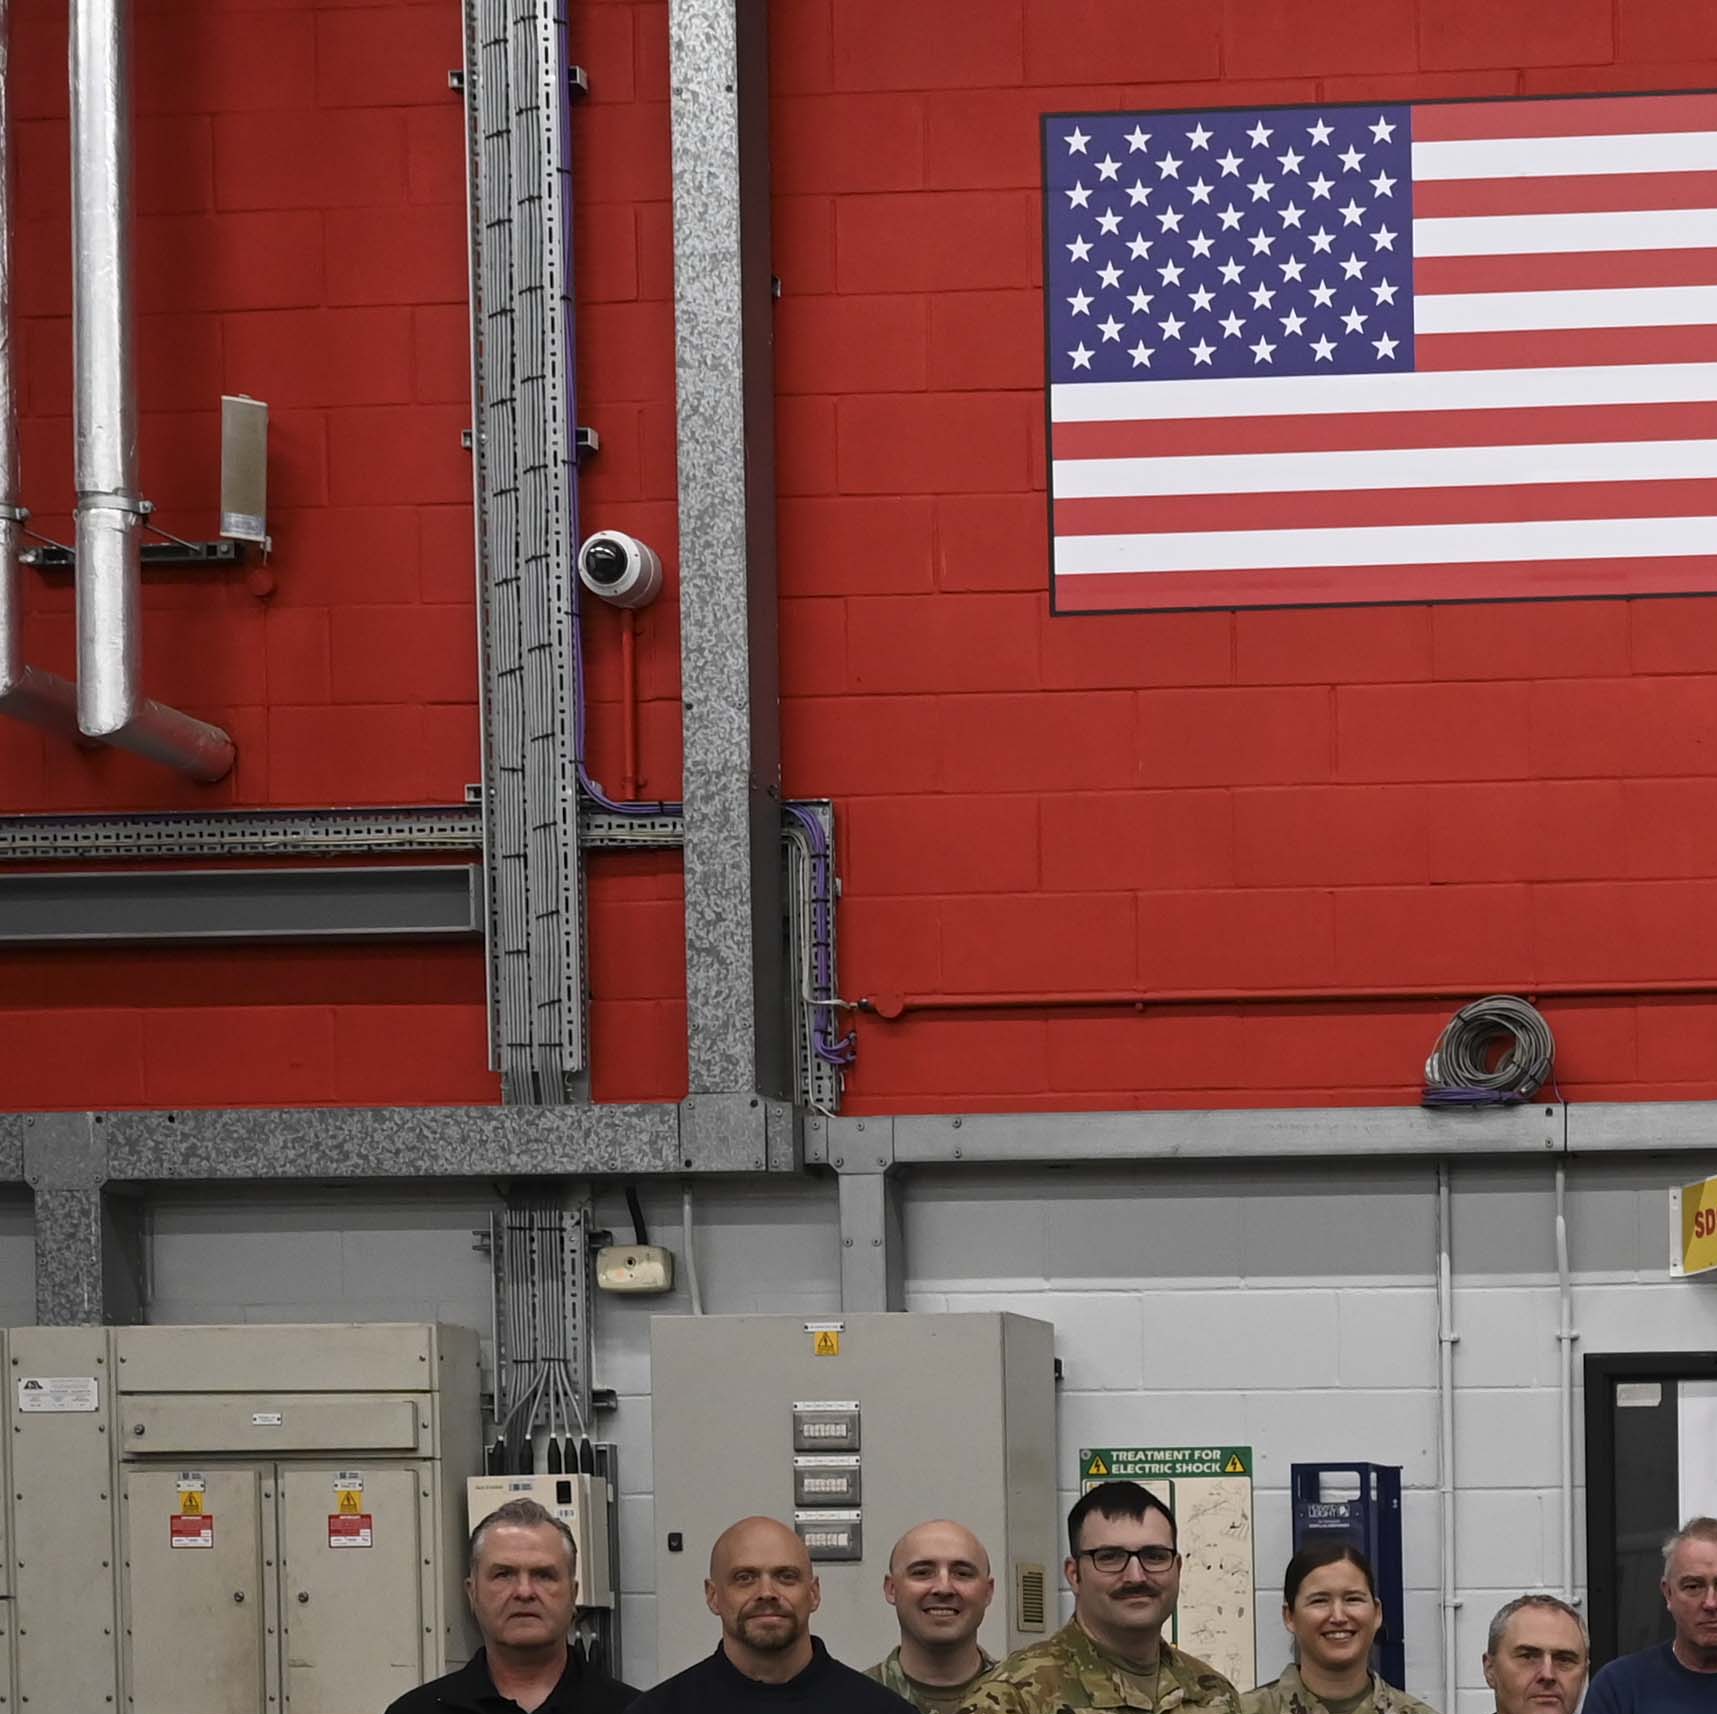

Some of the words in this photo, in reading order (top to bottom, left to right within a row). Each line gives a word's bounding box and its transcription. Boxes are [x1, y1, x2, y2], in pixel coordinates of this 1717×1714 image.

[1111, 1450, 1191, 1462] TREATMENT
[1194, 1450, 1221, 1460] FOR
[1111, 1463, 1172, 1474] ELECTRIC
[1175, 1462, 1222, 1473] SHOCK
